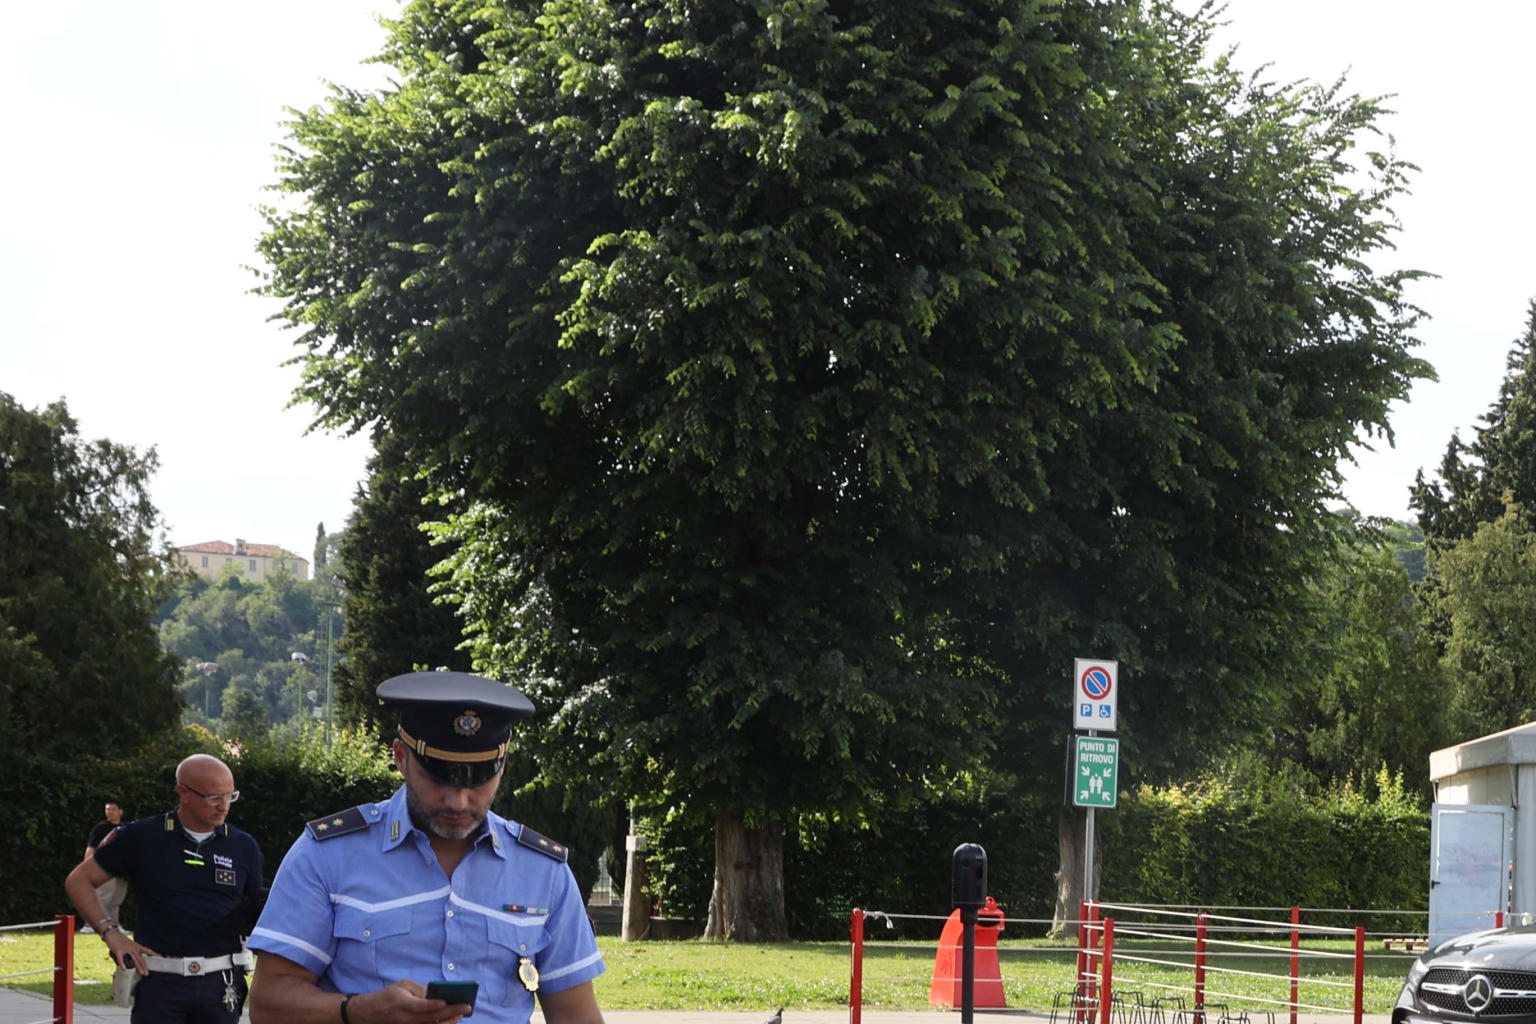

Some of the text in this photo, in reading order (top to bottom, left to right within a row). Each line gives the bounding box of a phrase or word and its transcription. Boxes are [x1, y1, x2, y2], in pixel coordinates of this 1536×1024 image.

[1082, 705, 1090, 715] P
[1080, 742, 1116, 752] PUNTO DI
[1080, 753, 1114, 764] RITROVO
